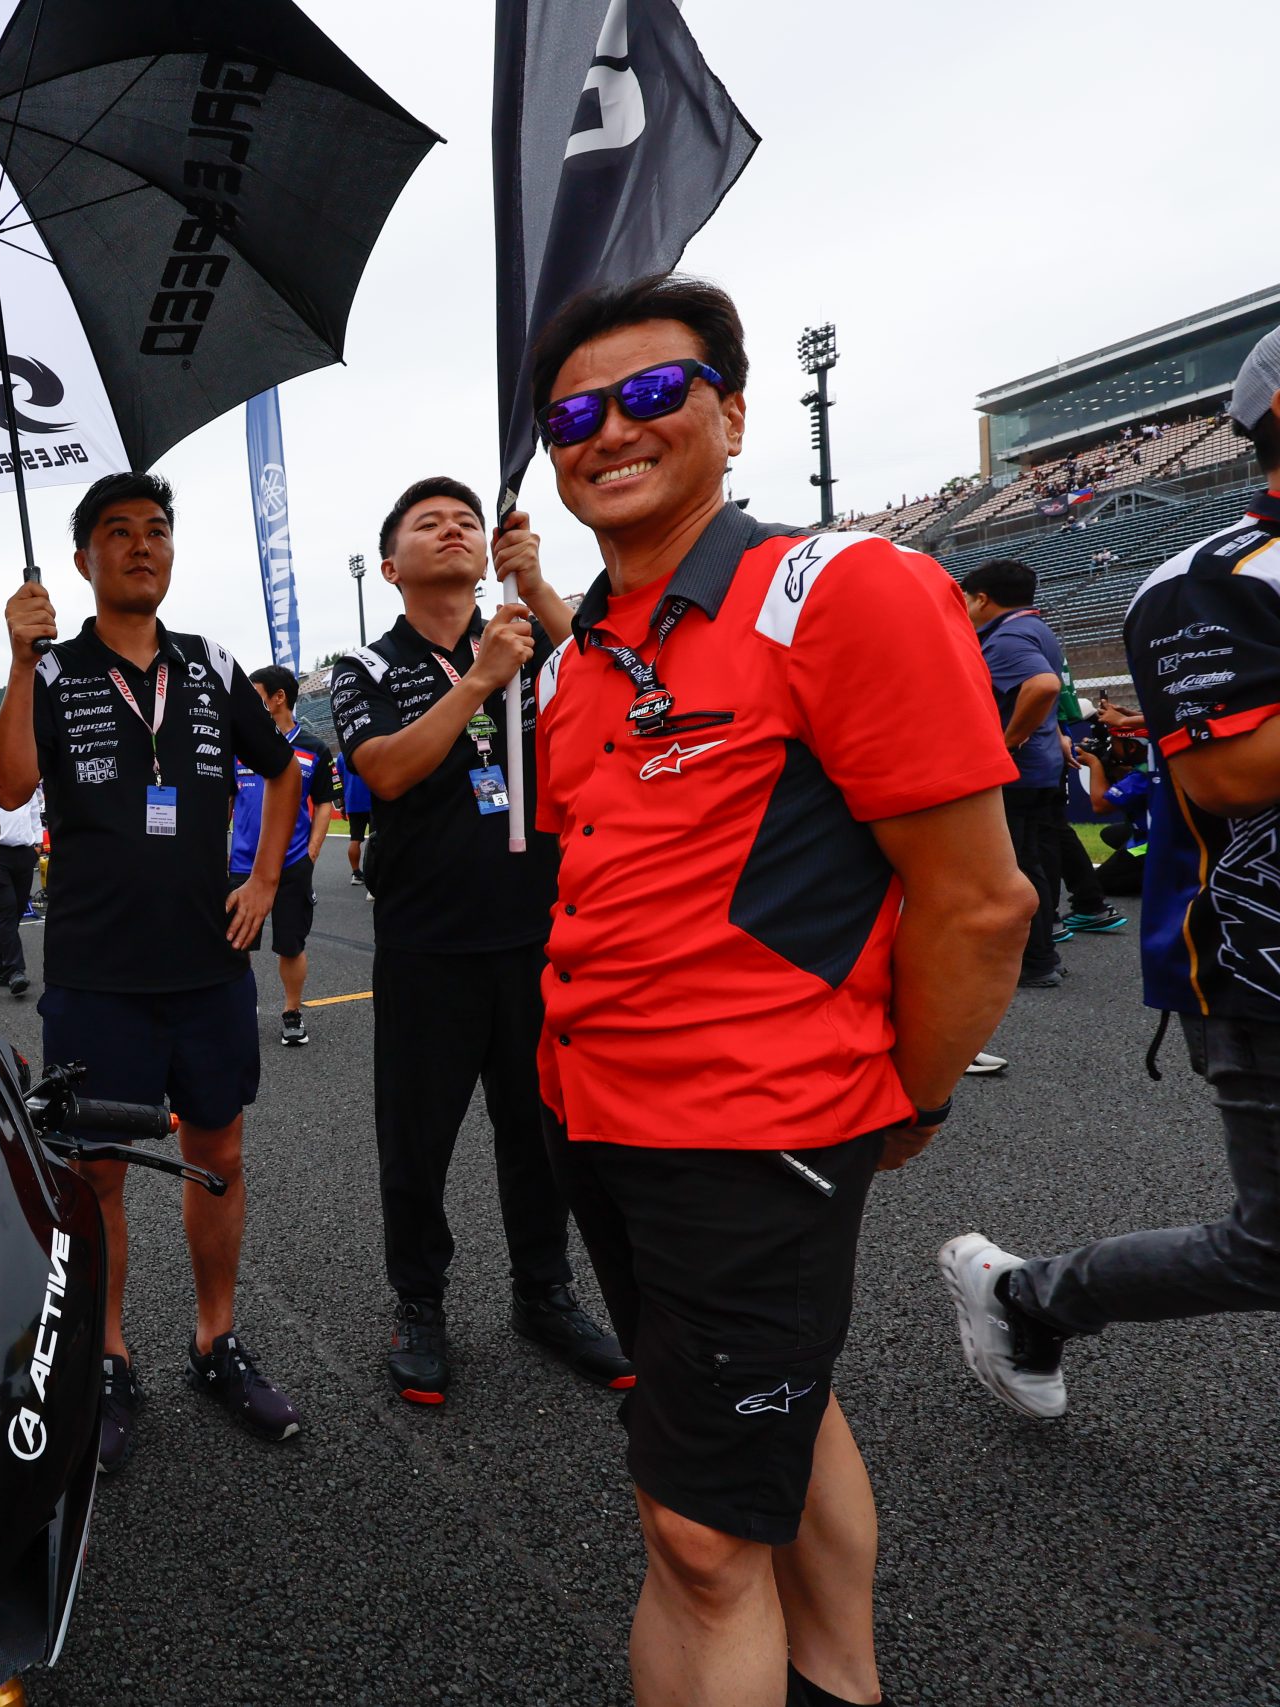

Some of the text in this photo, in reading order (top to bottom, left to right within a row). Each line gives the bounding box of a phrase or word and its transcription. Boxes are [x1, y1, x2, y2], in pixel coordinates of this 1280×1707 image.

[157, 666, 167, 699] JAPAN
[72, 689, 111, 699] ACTIVE
[73, 705, 113, 718] ADVANTAGE
[629, 698, 672, 719] GRID-ALL
[192, 724, 220, 738] TEC.2
[77, 758, 114, 771] Baby
[78, 770, 116, 782] Face
[29, 1227, 70, 1403] ACTIVE
